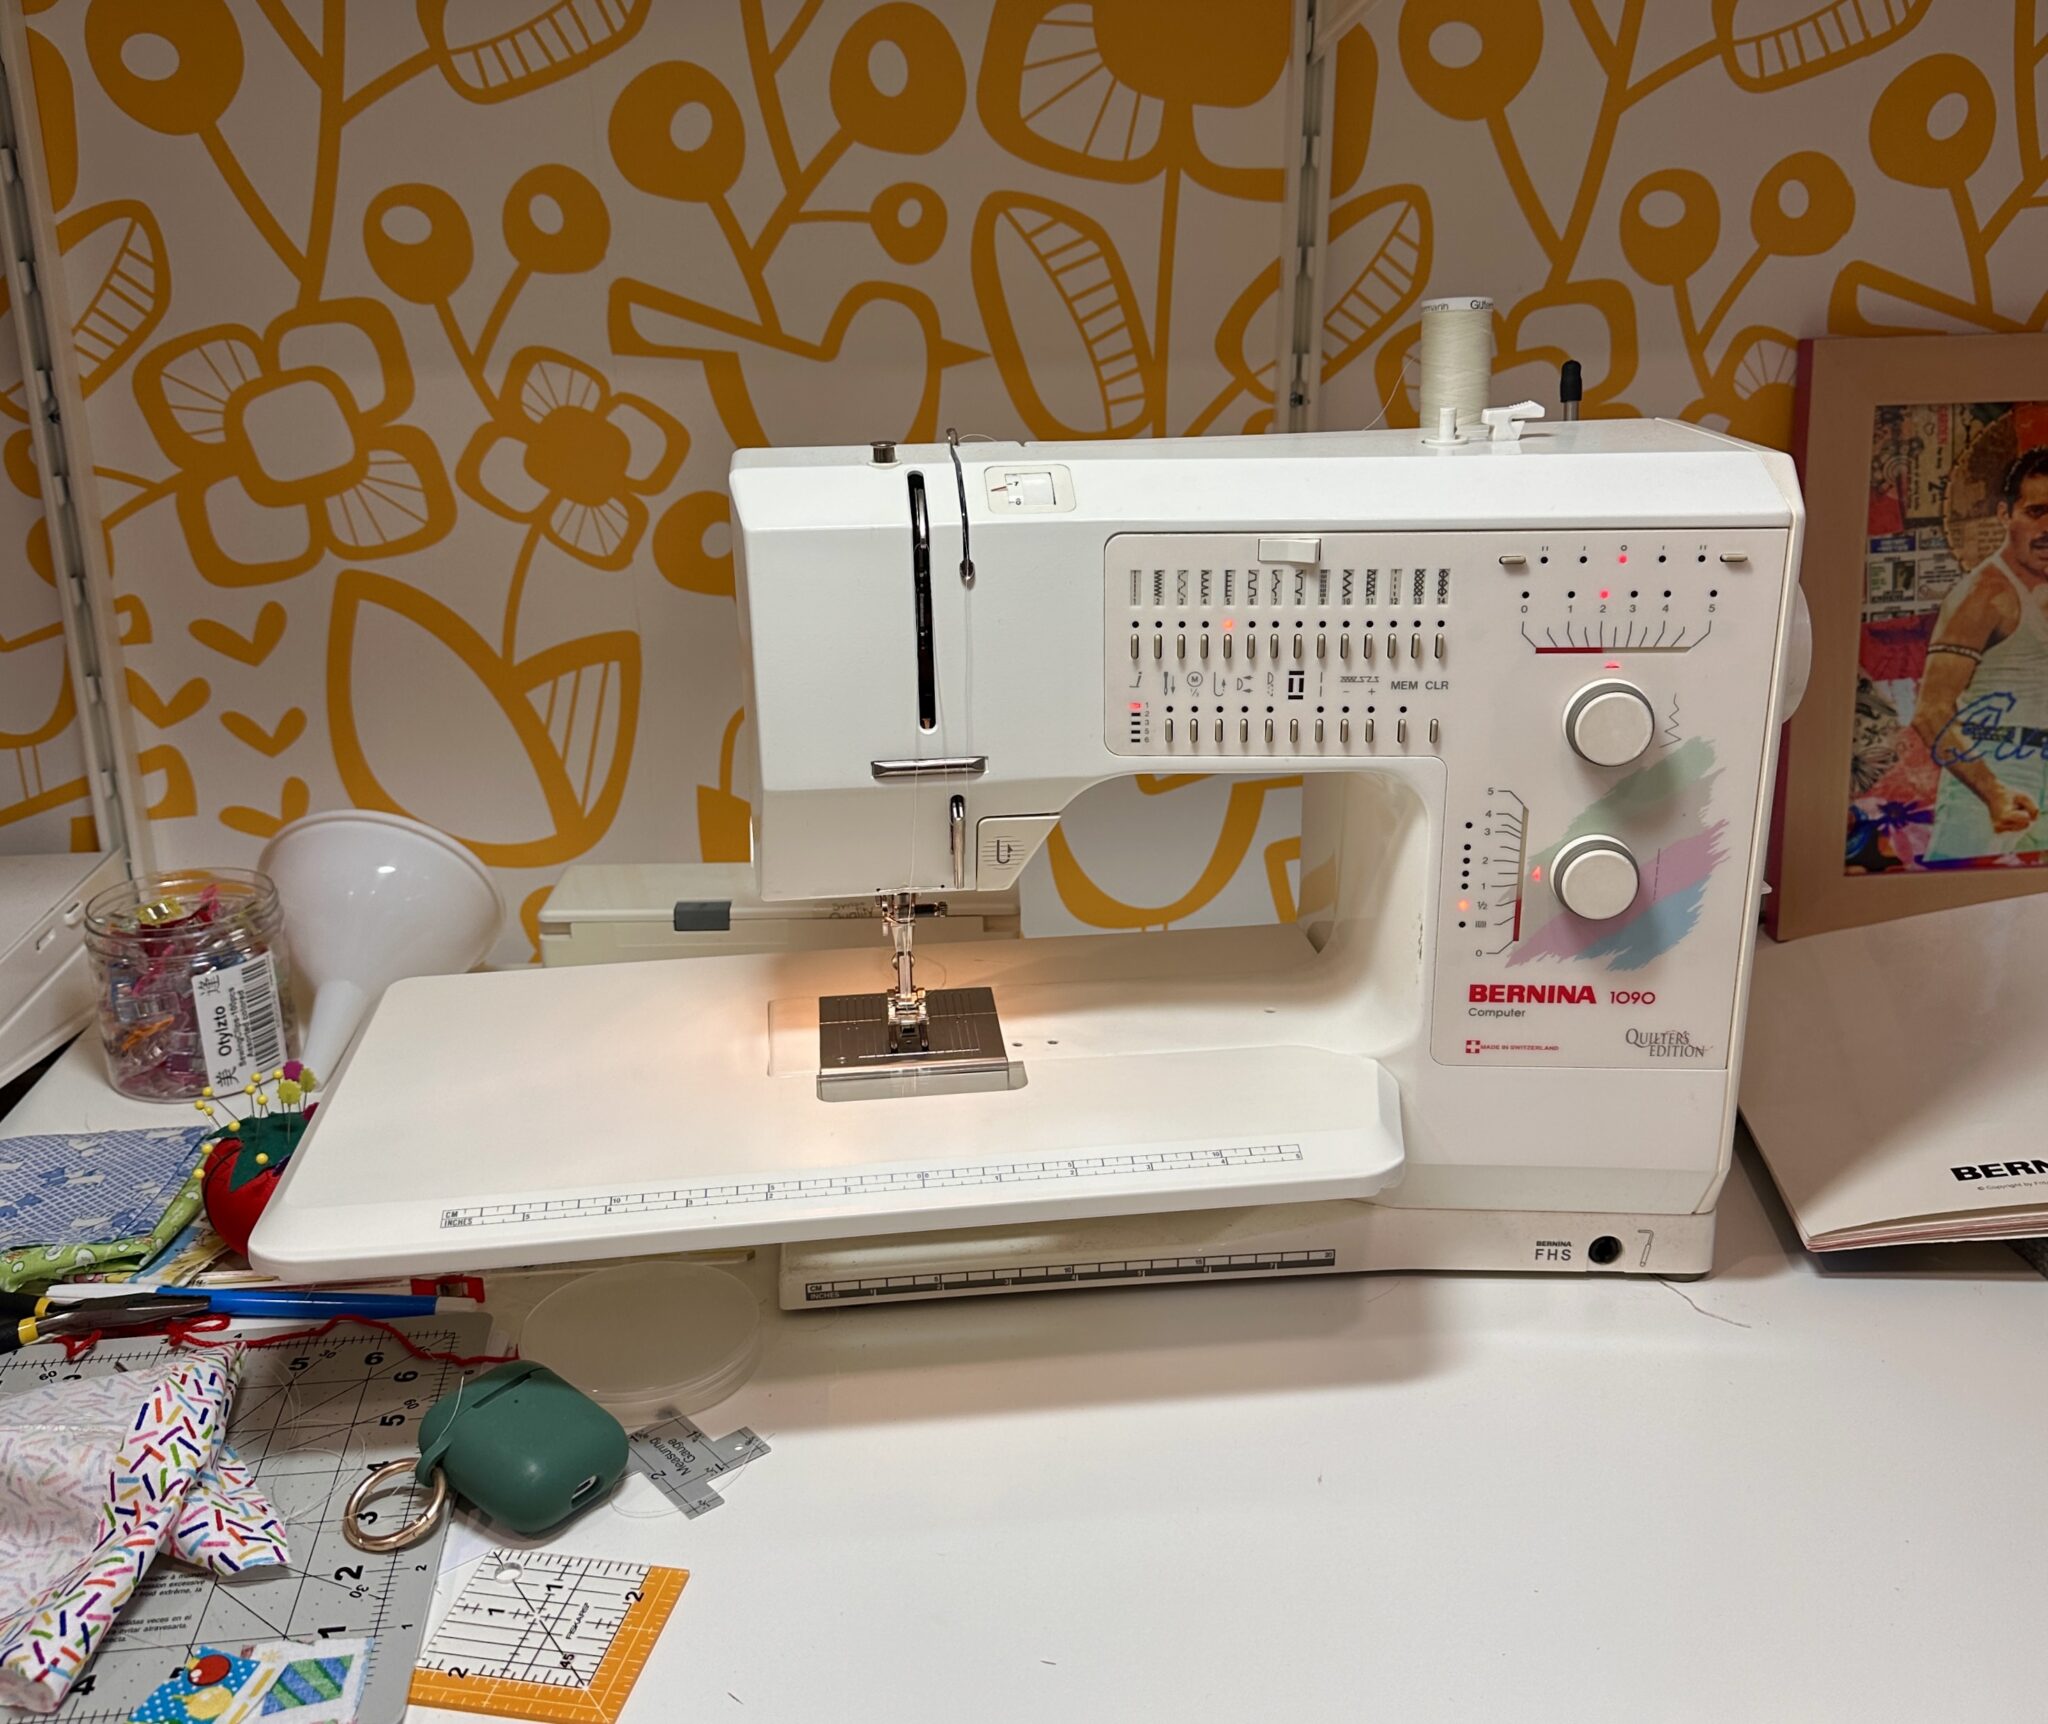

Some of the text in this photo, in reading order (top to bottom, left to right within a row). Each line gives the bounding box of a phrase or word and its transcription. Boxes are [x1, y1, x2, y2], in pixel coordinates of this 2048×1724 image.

[1521, 604, 1715, 614] 0 1 2 3 4 5
[1390, 681, 1449, 690] MEM CLR
[1487, 787, 1494, 795] 5
[1485, 810, 1492, 818] 4
[1484, 828, 1491, 836] 3
[1475, 949, 1482, 957] 0
[1468, 984, 1656, 1005] BERNINA 1090
[1468, 1007, 1526, 1019] Computer
[1649, 1045, 1706, 1058] EDITION
[215, 1066, 240, 1087] 美
[444, 1218, 472, 1227] INCHES
[1535, 1248, 1572, 1261] FHS
[319, 1349, 337, 1359] 30
[364, 1352, 384, 1365] 6
[288, 1357, 310, 1371] 5
[39, 1370, 57, 1381] 60
[394, 1370, 418, 1383] 6
[404, 1398, 419, 1410] 60
[379, 1414, 405, 1427] 5
[649, 1437, 691, 1476] Measuring
[667, 1438, 696, 1463] Gauge
[357, 1511, 378, 1525] 3
[334, 1564, 364, 1581] 2
[415, 1564, 428, 1572] 2
[349, 1584, 369, 1599] 30
[625, 1590, 645, 1602] 2
[488, 1606, 505, 1617] 1
[317, 1626, 346, 1638] 1
[559, 1653, 575, 1669] 45
[447, 1667, 469, 1679] 2
[70, 1675, 97, 1695] 4
